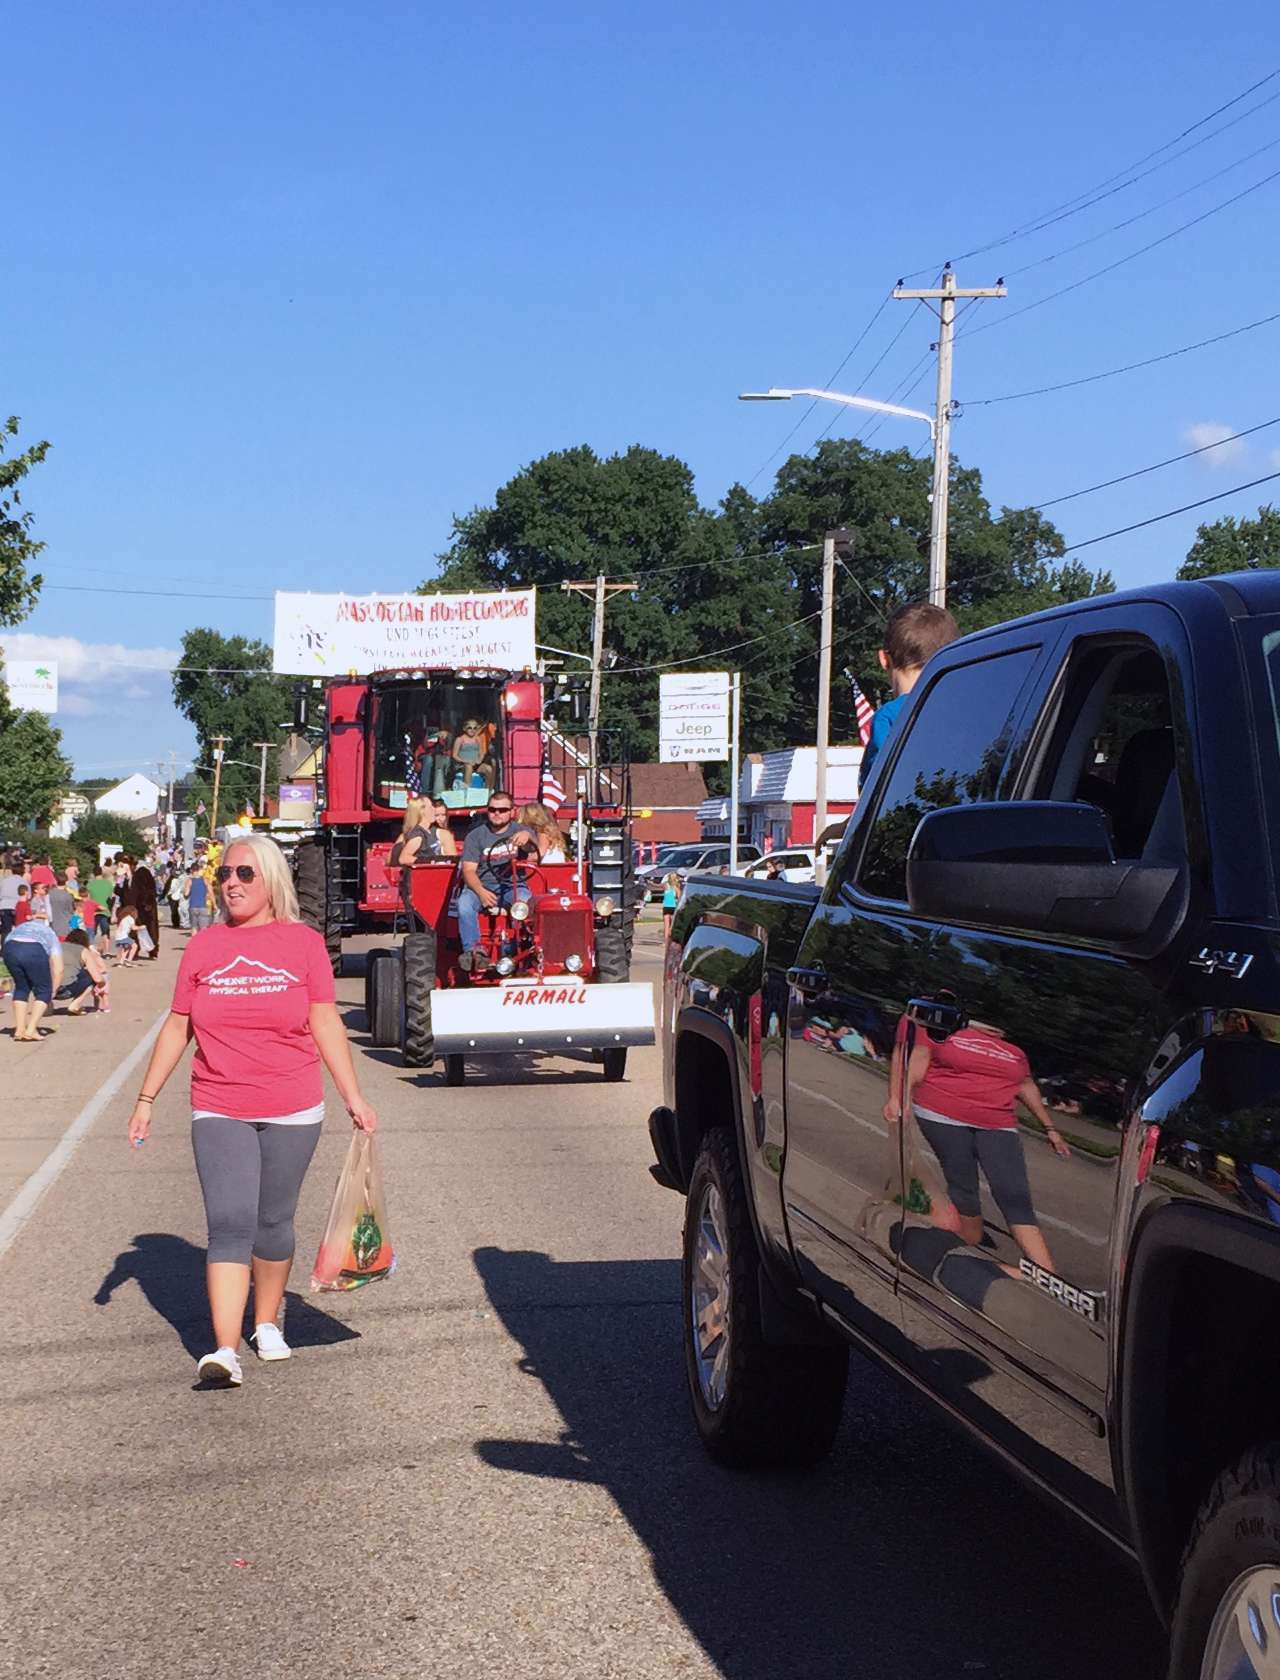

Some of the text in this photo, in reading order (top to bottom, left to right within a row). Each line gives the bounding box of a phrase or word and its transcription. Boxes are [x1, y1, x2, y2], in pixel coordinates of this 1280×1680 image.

[430, 597, 528, 621] HOMECOMING
[676, 721, 712, 736] Jeep
[209, 984, 289, 995] PHYSICAL THERAPY
[502, 989, 587, 1006] FARMALL
[1019, 1257, 1096, 1321] SIERRA
